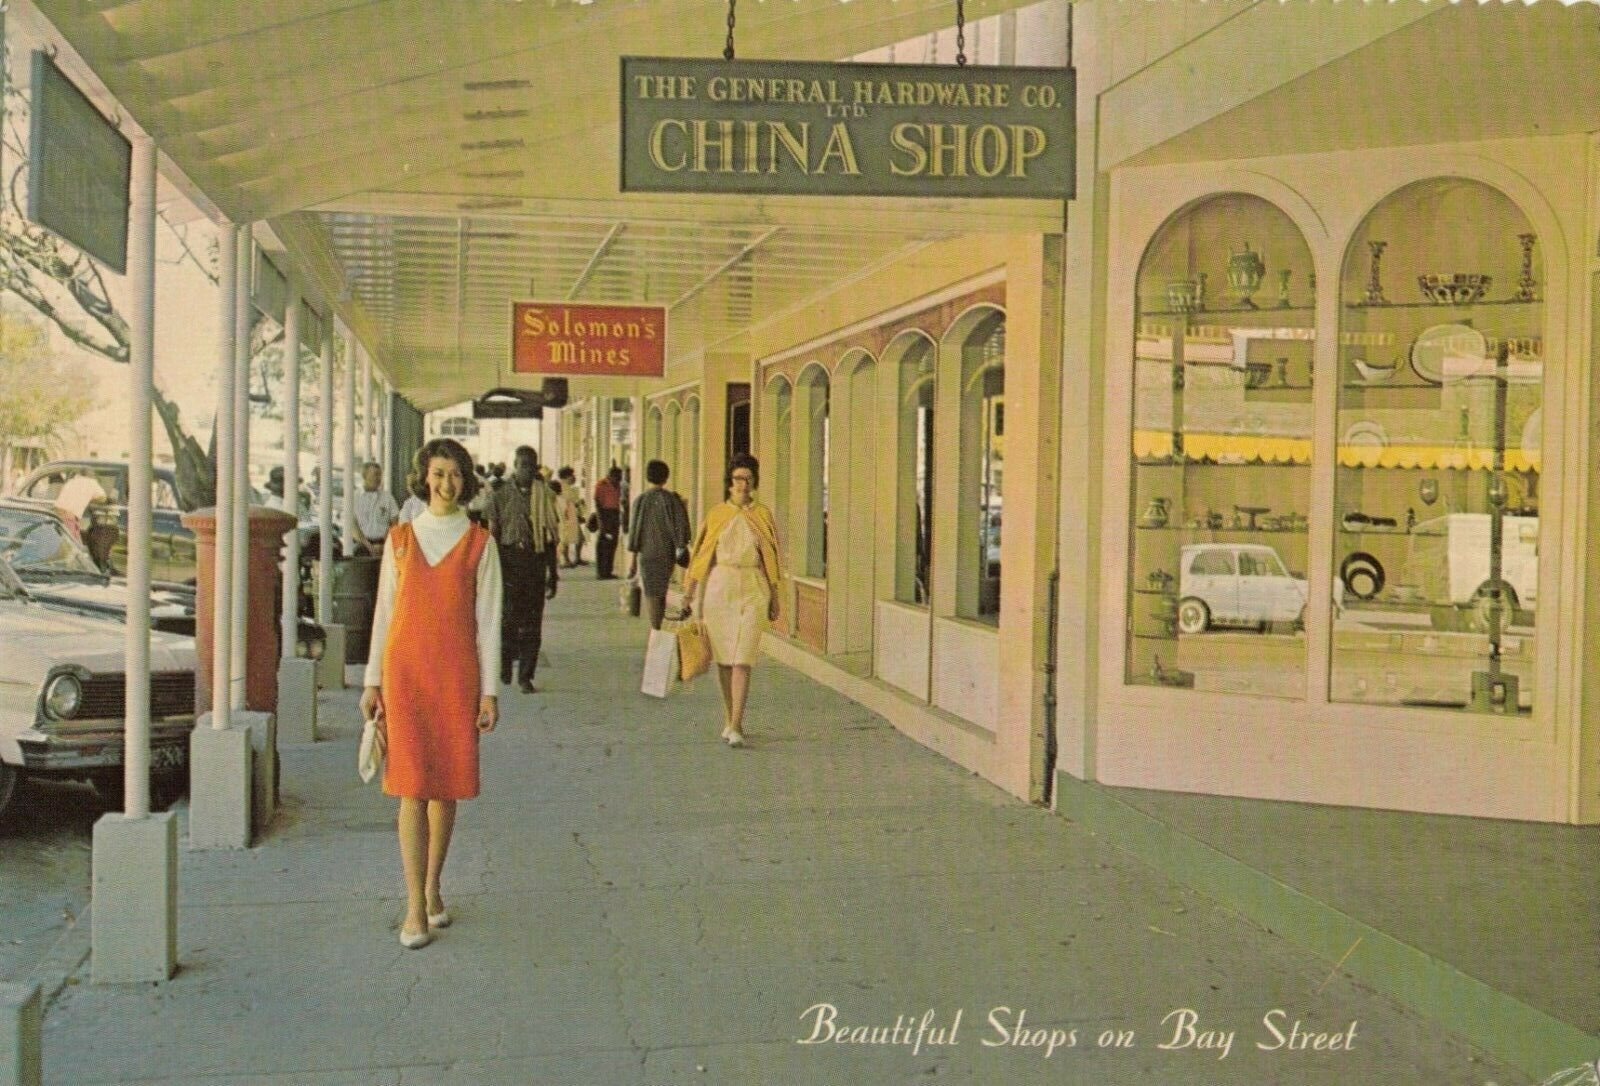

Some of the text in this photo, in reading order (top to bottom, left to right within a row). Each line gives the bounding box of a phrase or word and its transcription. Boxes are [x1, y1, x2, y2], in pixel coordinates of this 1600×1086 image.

[635, 76, 1061, 108] THE GENERAL HARDWARE CO.
[650, 119, 1046, 177] CHINA SHOP
[522, 309, 655, 338] Solomon's
[548, 341, 630, 365] Mines
